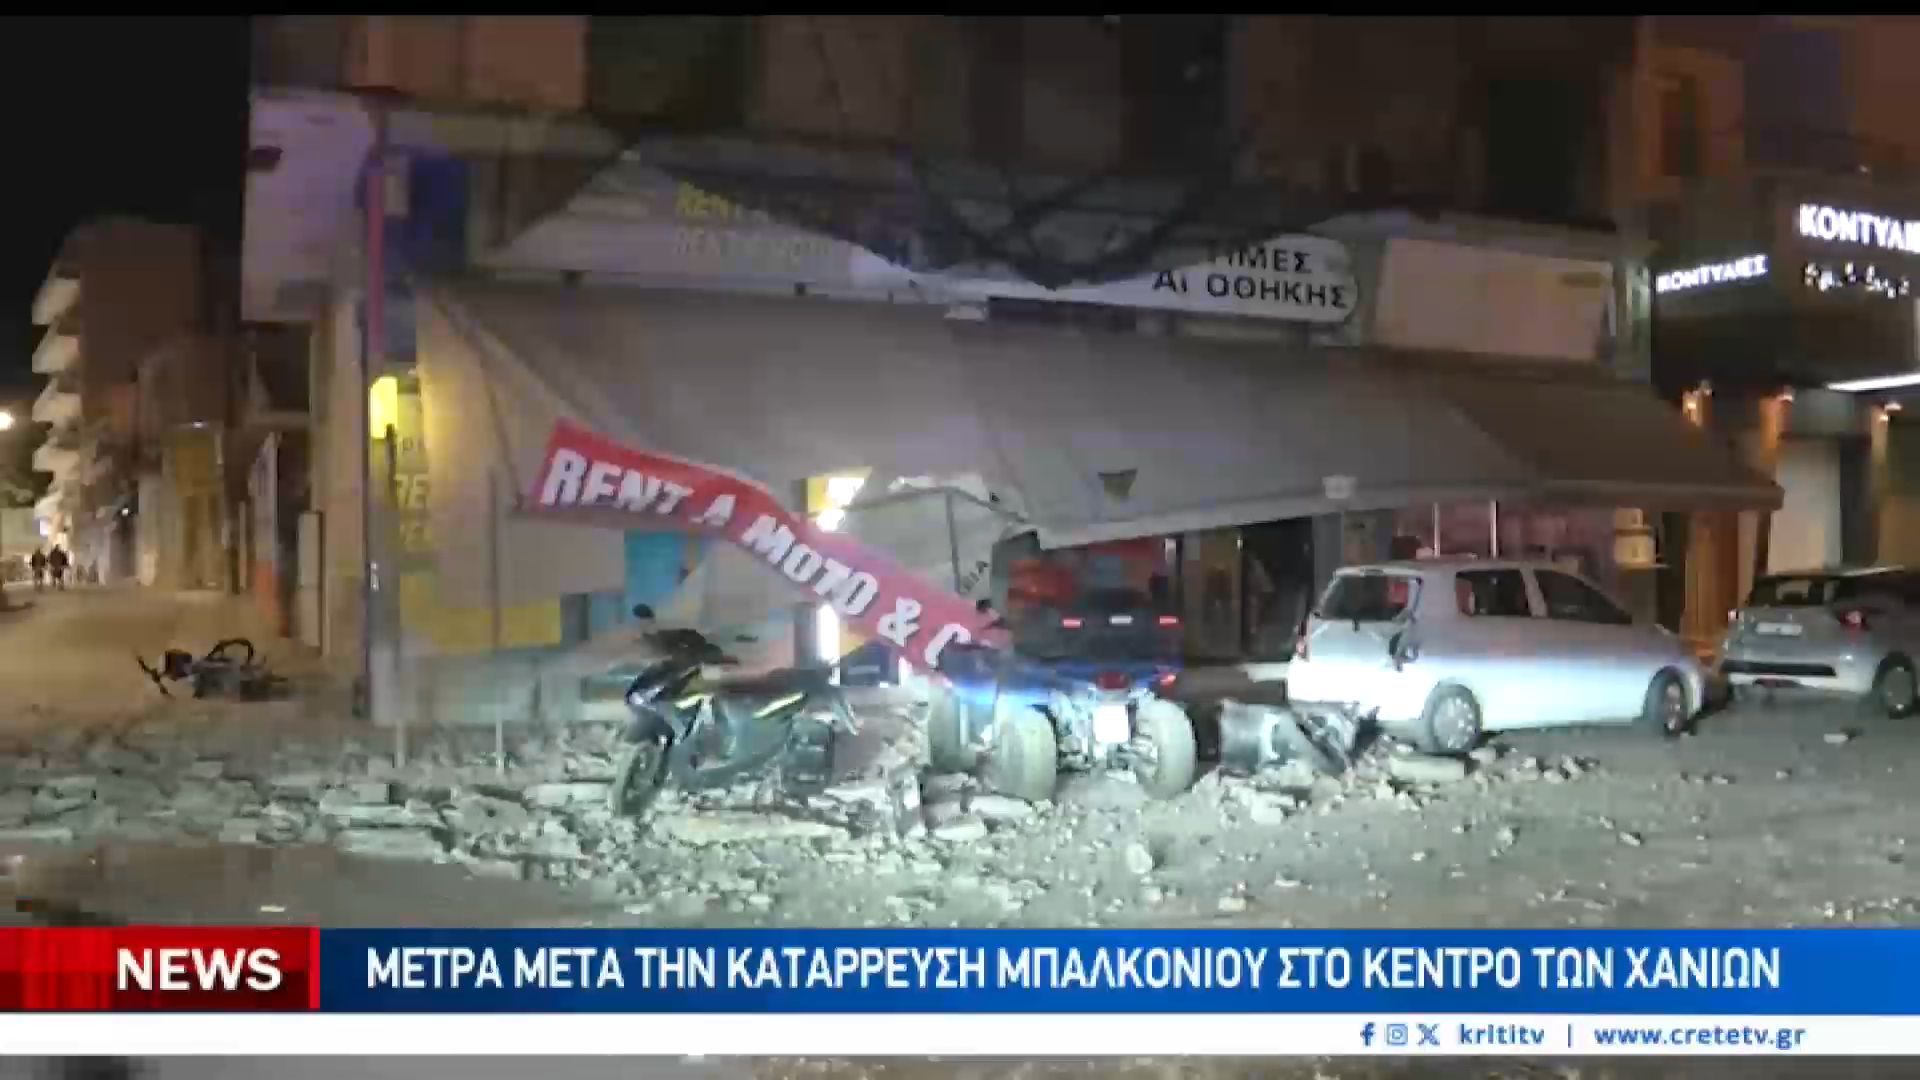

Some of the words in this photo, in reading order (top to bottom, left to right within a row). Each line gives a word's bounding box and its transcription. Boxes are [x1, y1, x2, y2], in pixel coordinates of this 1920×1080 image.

[539, 447, 694, 514] RENT
[690, 494, 737, 527] A
[742, 515, 878, 615] MOTO
[876, 596, 922, 646] &
